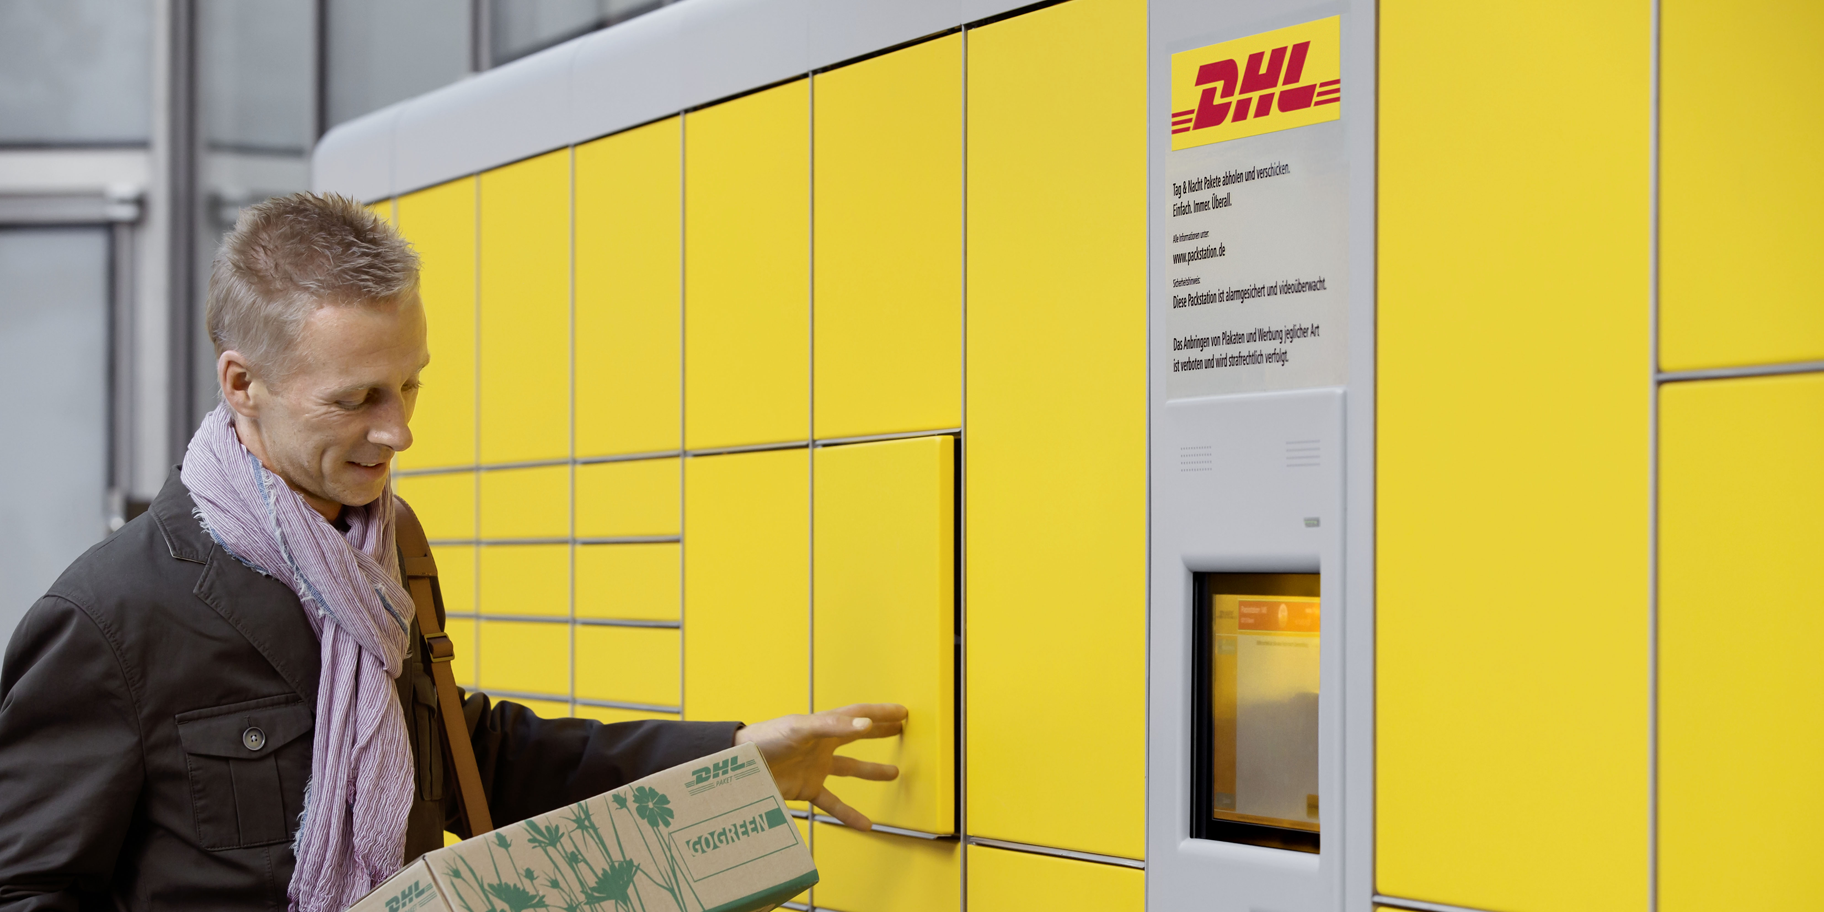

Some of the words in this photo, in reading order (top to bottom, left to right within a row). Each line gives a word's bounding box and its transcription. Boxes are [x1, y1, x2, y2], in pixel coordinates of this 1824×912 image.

[1192, 40, 1318, 131] DHL
[1173, 183, 1182, 199] Tag
[1183, 181, 1188, 194] &
[1187, 177, 1203, 193] Nacht
[1203, 174, 1222, 190] Pakete
[1222, 169, 1244, 187] abholen
[1244, 166, 1256, 182] und
[1256, 161, 1290, 179] verschicken.
[1172, 201, 1193, 218] Einfach.
[1193, 198, 1211, 214] Immer.
[1211, 192, 1232, 210] Überall.
[1172, 242, 1226, 267] www.packstation.de
[1172, 294, 1187, 309] Diese
[1188, 289, 1217, 307] Packstation
[1225, 283, 1266, 304] alarmgesichert
[1266, 280, 1278, 297] und
[1279, 276, 1327, 295] videoüberwacht.
[1173, 336, 1183, 352] Das
[1183, 334, 1210, 352] Anbringen
[1210, 335, 1221, 347] von
[1221, 330, 1246, 347] Plakaten
[1246, 327, 1257, 344] und
[1257, 325, 1283, 345] Werbung
[1283, 323, 1309, 345] jeglicher
[1309, 323, 1320, 338] Art
[1180, 356, 1204, 372] verboten
[1204, 354, 1215, 370] und
[1215, 352, 1228, 369] wird
[1228, 349, 1264, 367] strafrechtlich
[1264, 348, 1289, 368] verfolgt.
[691, 755, 746, 785] DHL
[715, 776, 733, 787] PAKET
[687, 813, 769, 857] GOGREEN
[384, 880, 425, 912] DHL
